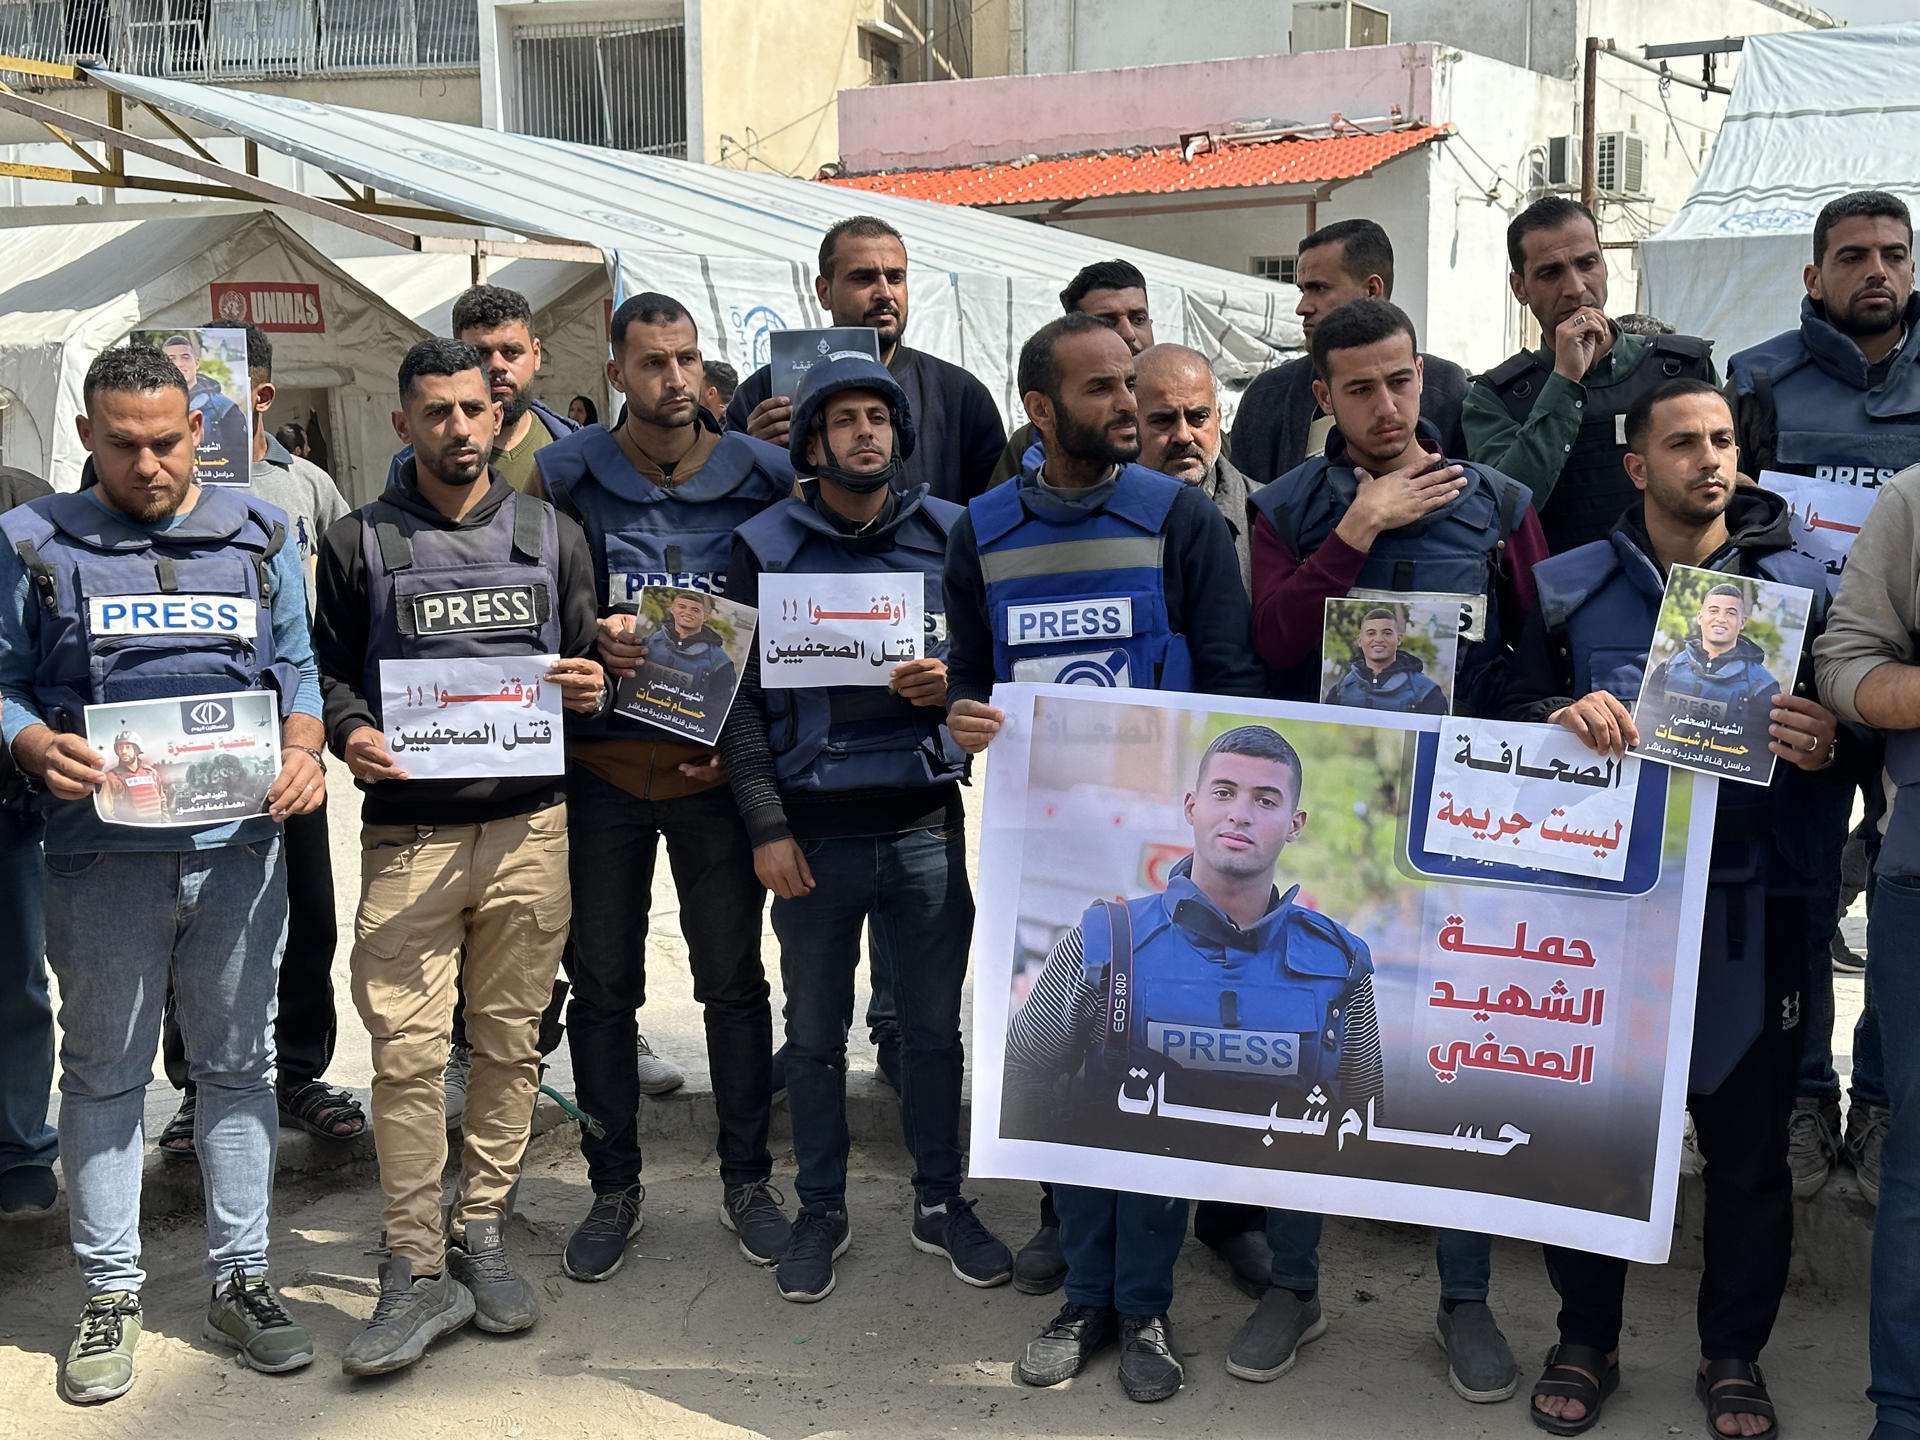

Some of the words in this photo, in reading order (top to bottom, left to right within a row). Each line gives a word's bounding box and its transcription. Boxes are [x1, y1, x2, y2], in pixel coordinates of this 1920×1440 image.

[250, 291, 319, 325] UNMAS
[102, 602, 239, 631] PRESS
[423, 591, 531, 628] PRESS
[807, 593, 906, 627] أوقفوا
[1019, 606, 1121, 640] PRESS
[766, 636, 865, 664] الصحفيين
[870, 638, 915, 667] قتل
[433, 674, 541, 709] أوقفوا
[671, 701, 706, 719] حسام
[391, 721, 497, 753] الصحفيين
[502, 720, 552, 751] قتل
[1655, 724, 1701, 747] شبات
[1701, 736, 1749, 755] حسام
[1711, 722, 1743, 735] الشهيد
[1454, 733, 1622, 789] الصحافة
[1644, 741, 1671, 755] مباشر
[1672, 748, 1703, 762] الجزيرة
[1704, 756, 1722, 766] قناة
[1723, 760, 1751, 772] مراسل
[1436, 790, 1533, 845] جريمة
[1540, 807, 1623, 859] ليست
[1438, 914, 1597, 969] حملة
[1114, 973, 1127, 996] 80D
[1113, 998, 1126, 1033] EOS
[1428, 978, 1605, 1027] الشهيد
[1162, 1029, 1293, 1069] PRESS
[1427, 1031, 1595, 1085] الصحفي
[1116, 1066, 1331, 1148] شبات
[1337, 1095, 1531, 1157] حسام
